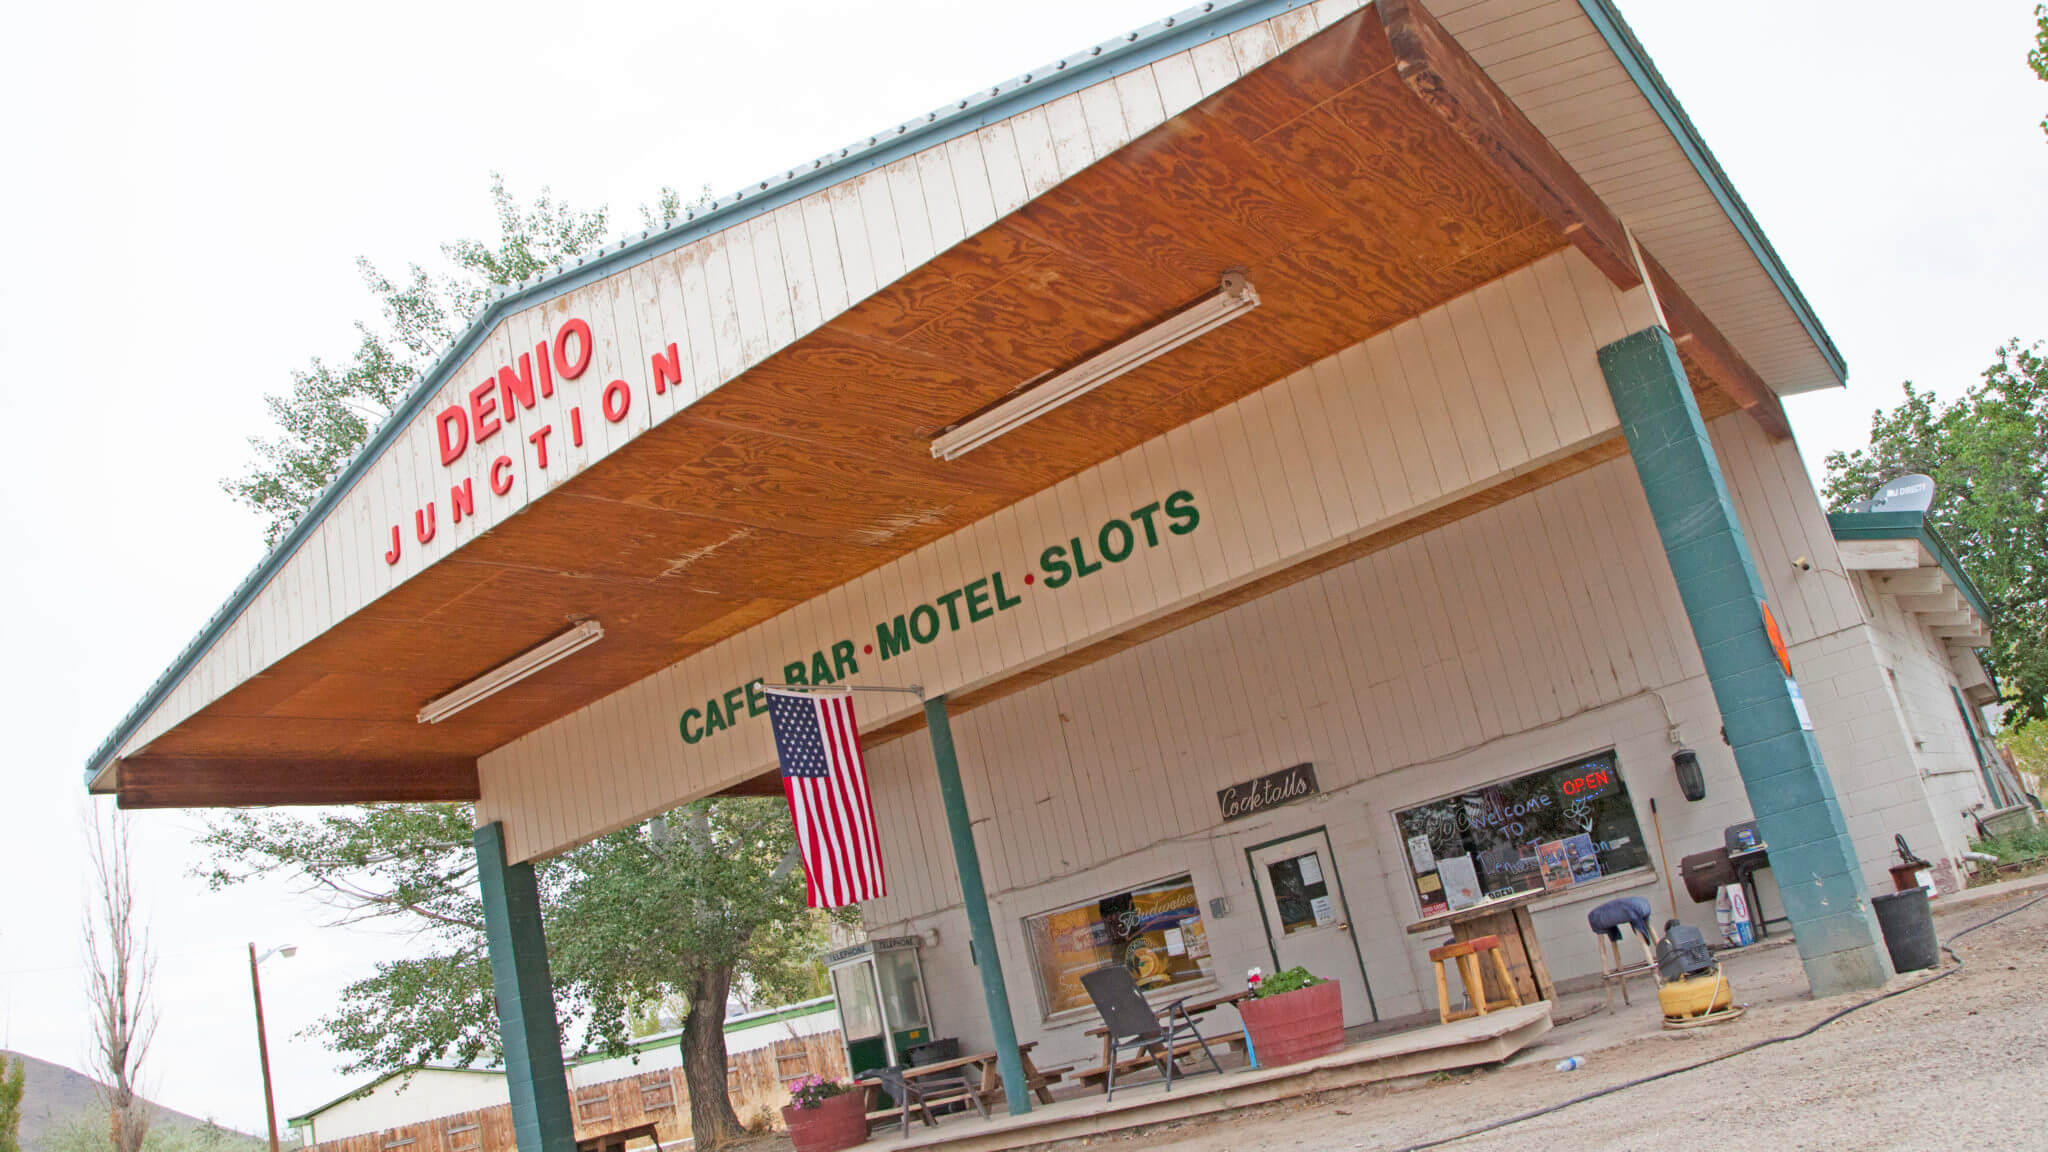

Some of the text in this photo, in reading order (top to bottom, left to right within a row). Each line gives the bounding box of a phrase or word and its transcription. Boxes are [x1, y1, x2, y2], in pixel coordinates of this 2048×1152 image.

[385, 342, 682, 565] JUNCTION
[436, 318, 593, 467] DENIO
[679, 490, 1200, 744] CAFE BAR MOTEL SLOTS
[1222, 771, 1307, 817] Cocktails
[1562, 770, 1609, 795] OPEN
